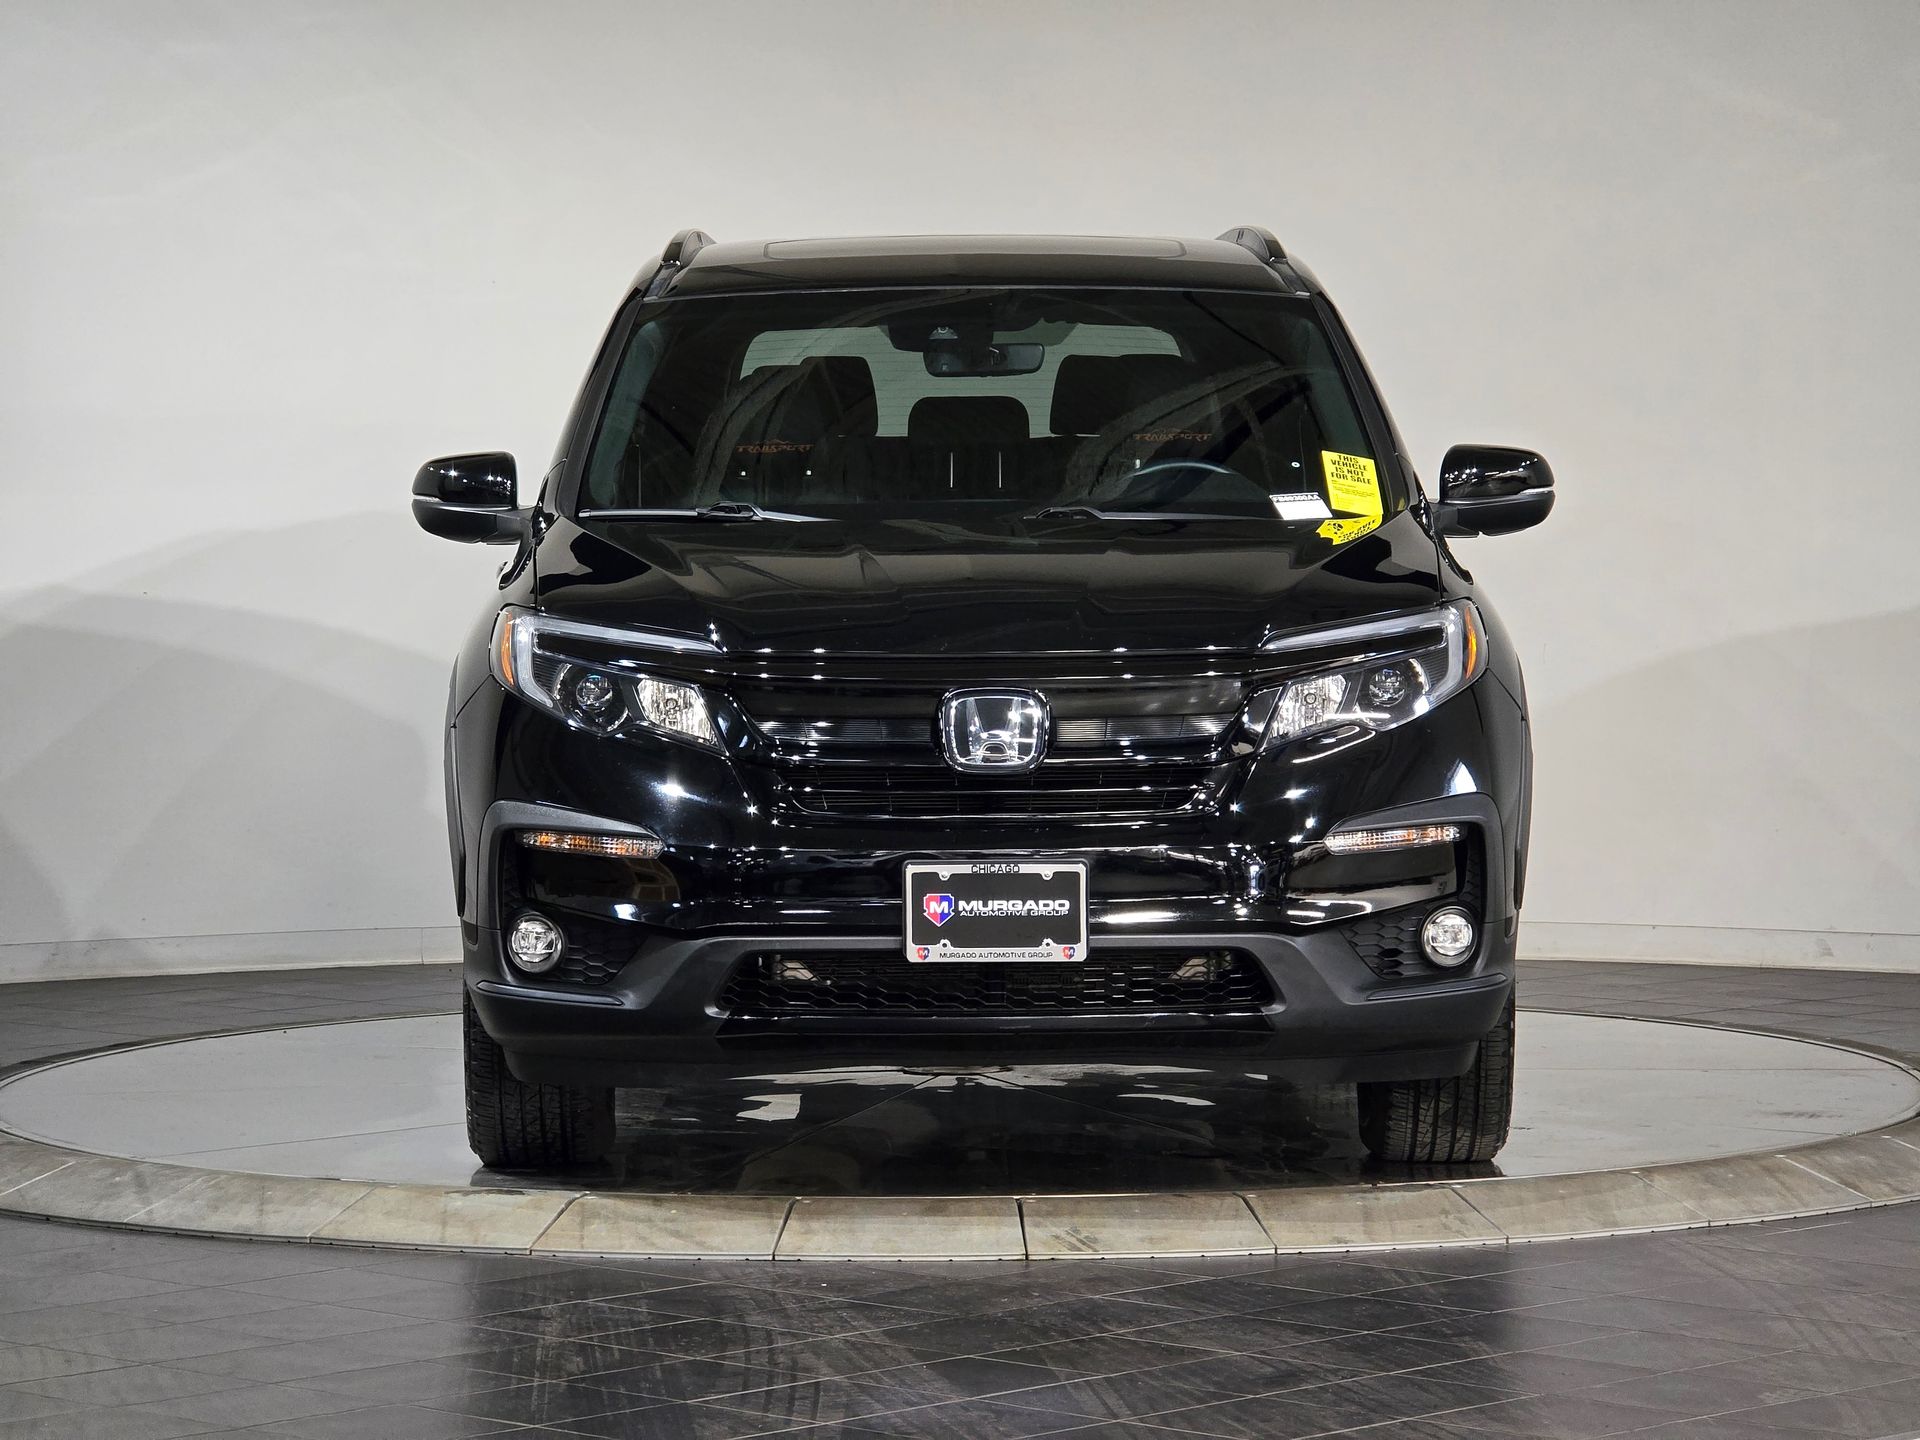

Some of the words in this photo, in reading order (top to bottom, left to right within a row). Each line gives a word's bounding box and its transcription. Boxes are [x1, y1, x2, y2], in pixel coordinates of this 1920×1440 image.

[1330, 459, 1368, 471] VEHICLE
[1337, 454, 1359, 464] THIS
[1335, 466, 1345, 474] IS
[1347, 468, 1364, 477] NOT
[1330, 471, 1349, 481] FOR
[1350, 475, 1372, 485] SALE
[971, 864, 1020, 874] CHICAGO
[929, 901, 949, 913] M
[958, 899, 1071, 911] MURGADO
